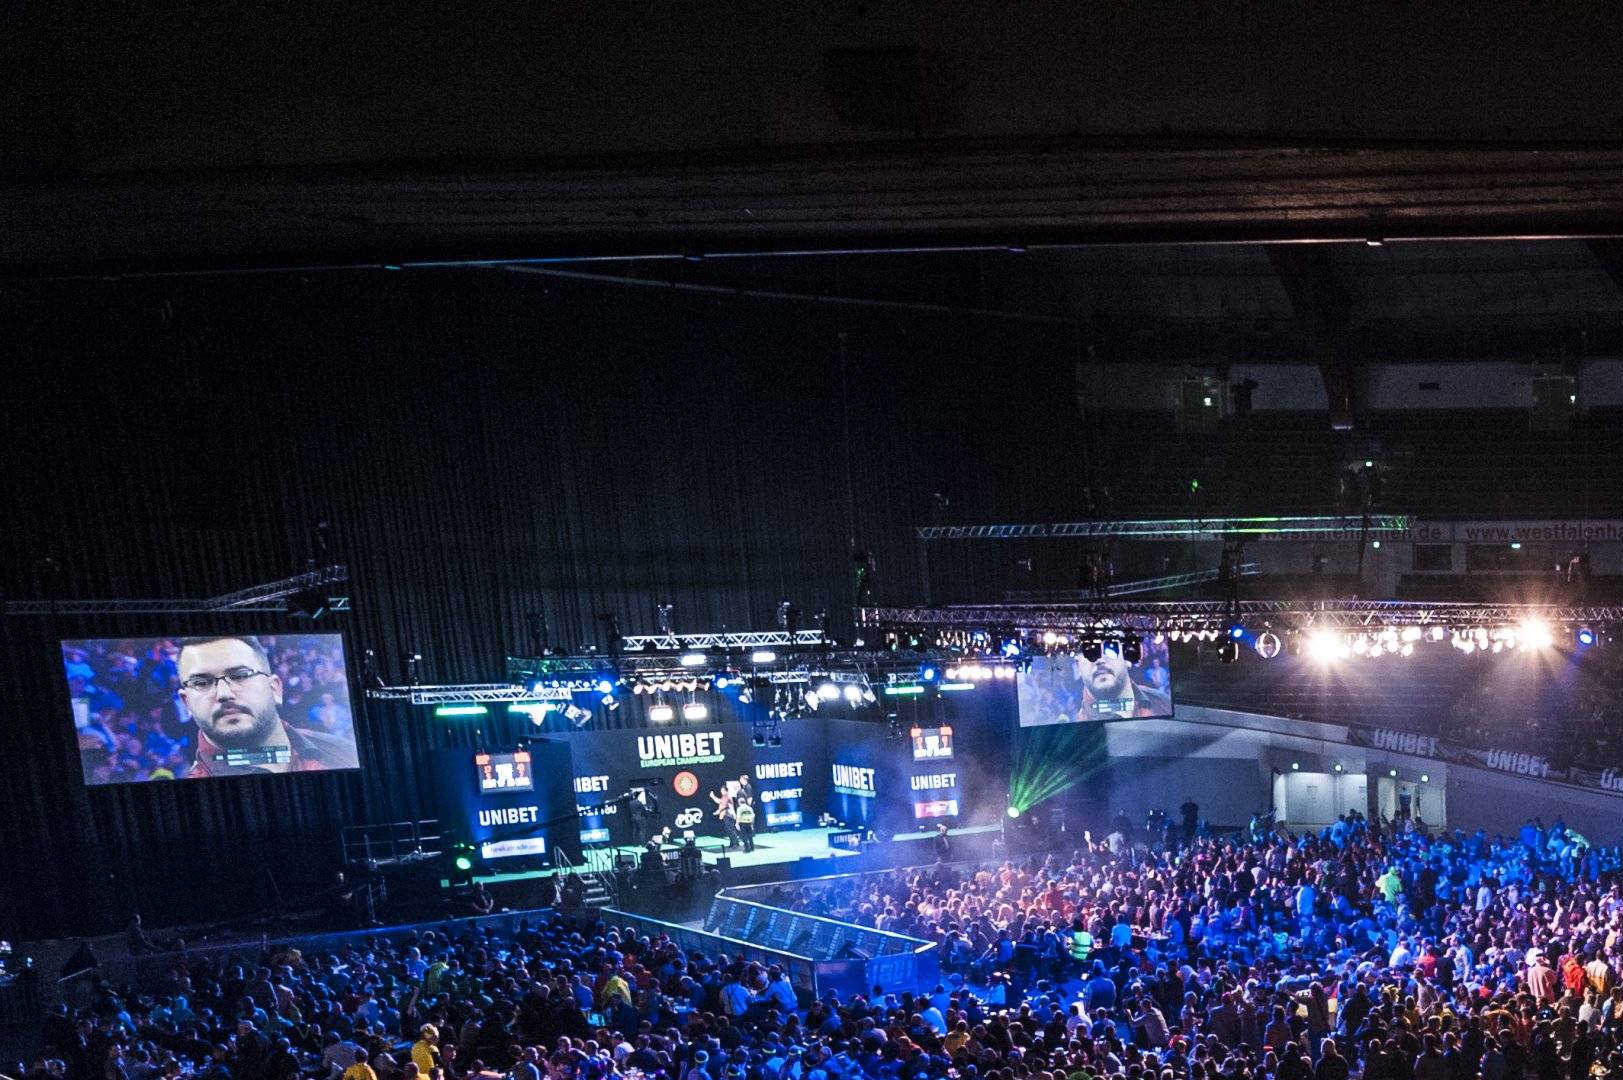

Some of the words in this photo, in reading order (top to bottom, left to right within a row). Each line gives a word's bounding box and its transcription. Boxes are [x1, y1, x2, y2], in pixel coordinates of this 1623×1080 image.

[637, 731, 724, 760] UNIBET
[1373, 728, 1440, 757] UNIBET
[755, 761, 803, 780] UNIBET
[832, 763, 875, 791] UNIBET
[1487, 748, 1551, 778] UNIBET
[911, 773, 957, 790] UNIBET
[479, 806, 538, 826] UNIBET
